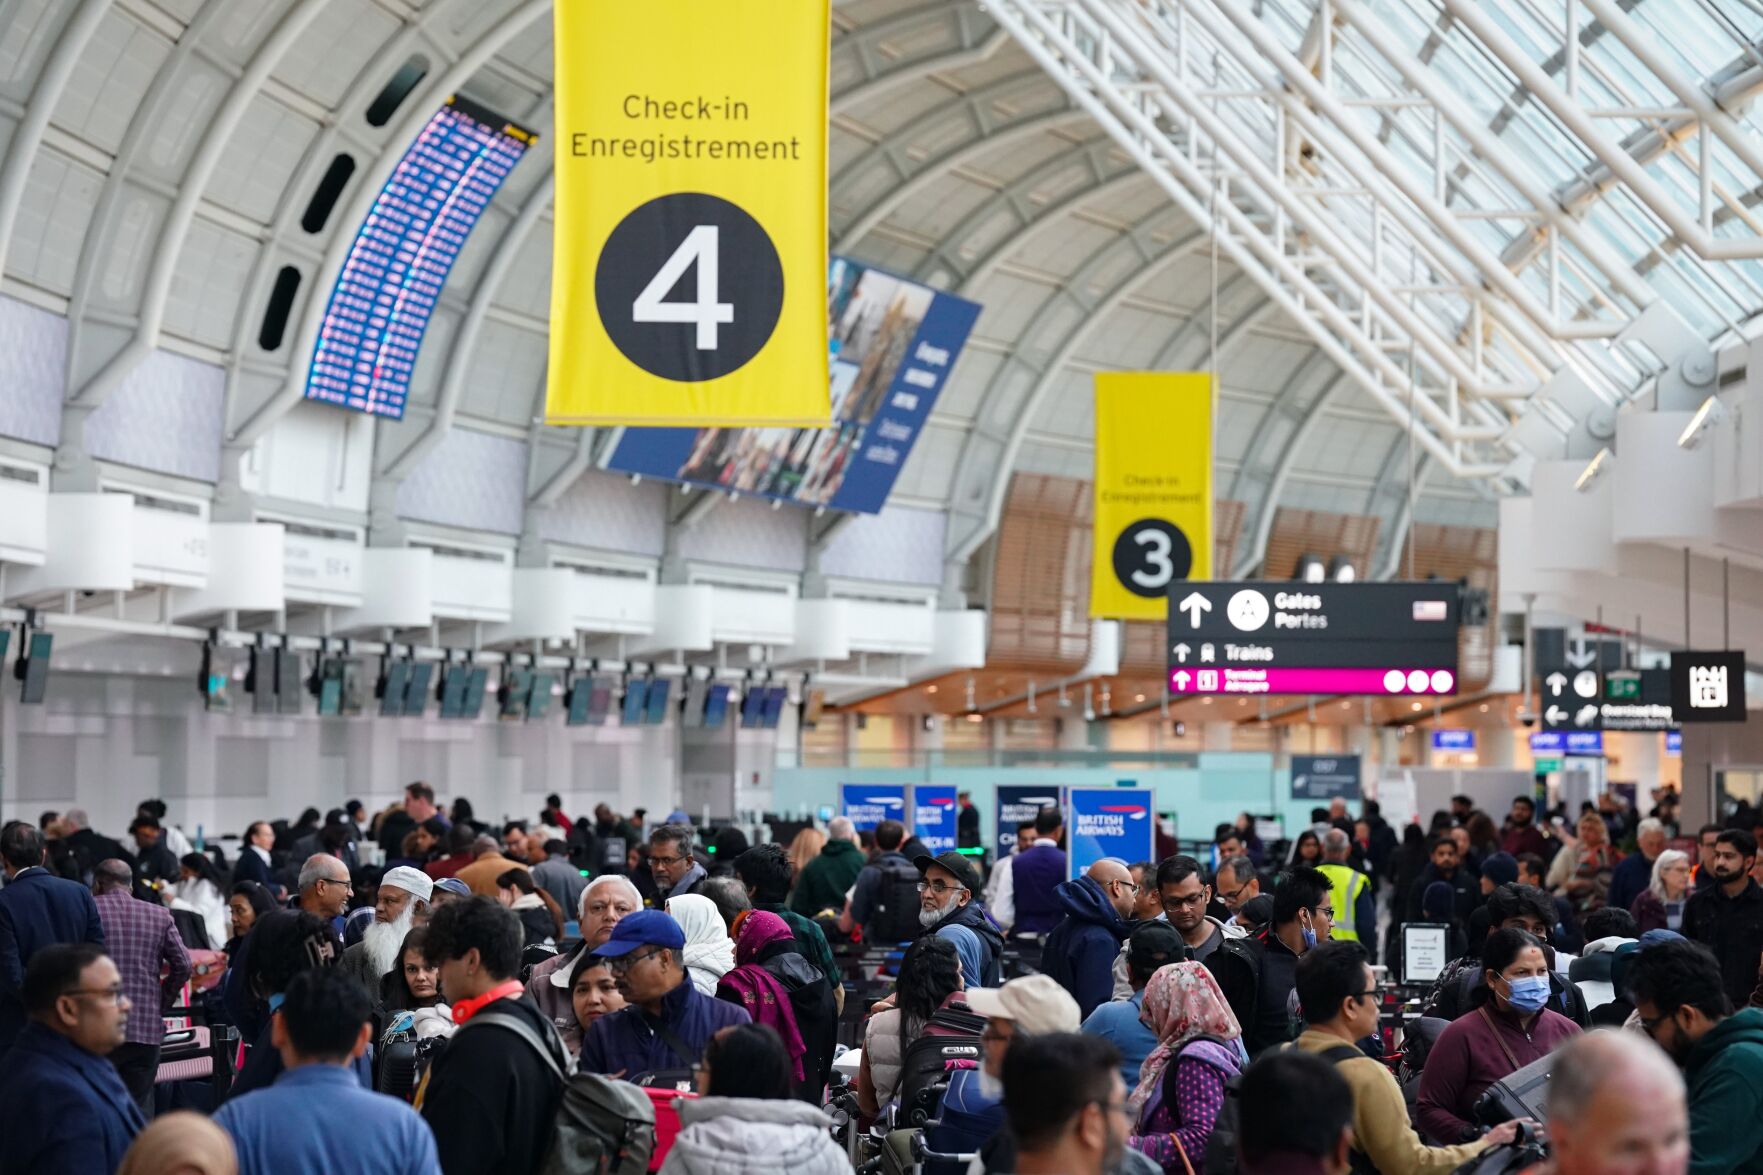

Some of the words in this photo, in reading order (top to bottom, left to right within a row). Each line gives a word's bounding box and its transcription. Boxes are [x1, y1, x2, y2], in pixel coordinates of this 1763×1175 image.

[622, 94, 749, 121] Check-in
[571, 132, 801, 164] Enregistrement
[632, 225, 734, 350] 4
[1131, 528, 1174, 588] 3
[1274, 592, 1322, 610] Gates
[1274, 612, 1328, 629] Portes
[1224, 644, 1274, 661] Trains
[1077, 815, 1123, 825] BRITISH
[1075, 825, 1125, 837] AIRWAYS
